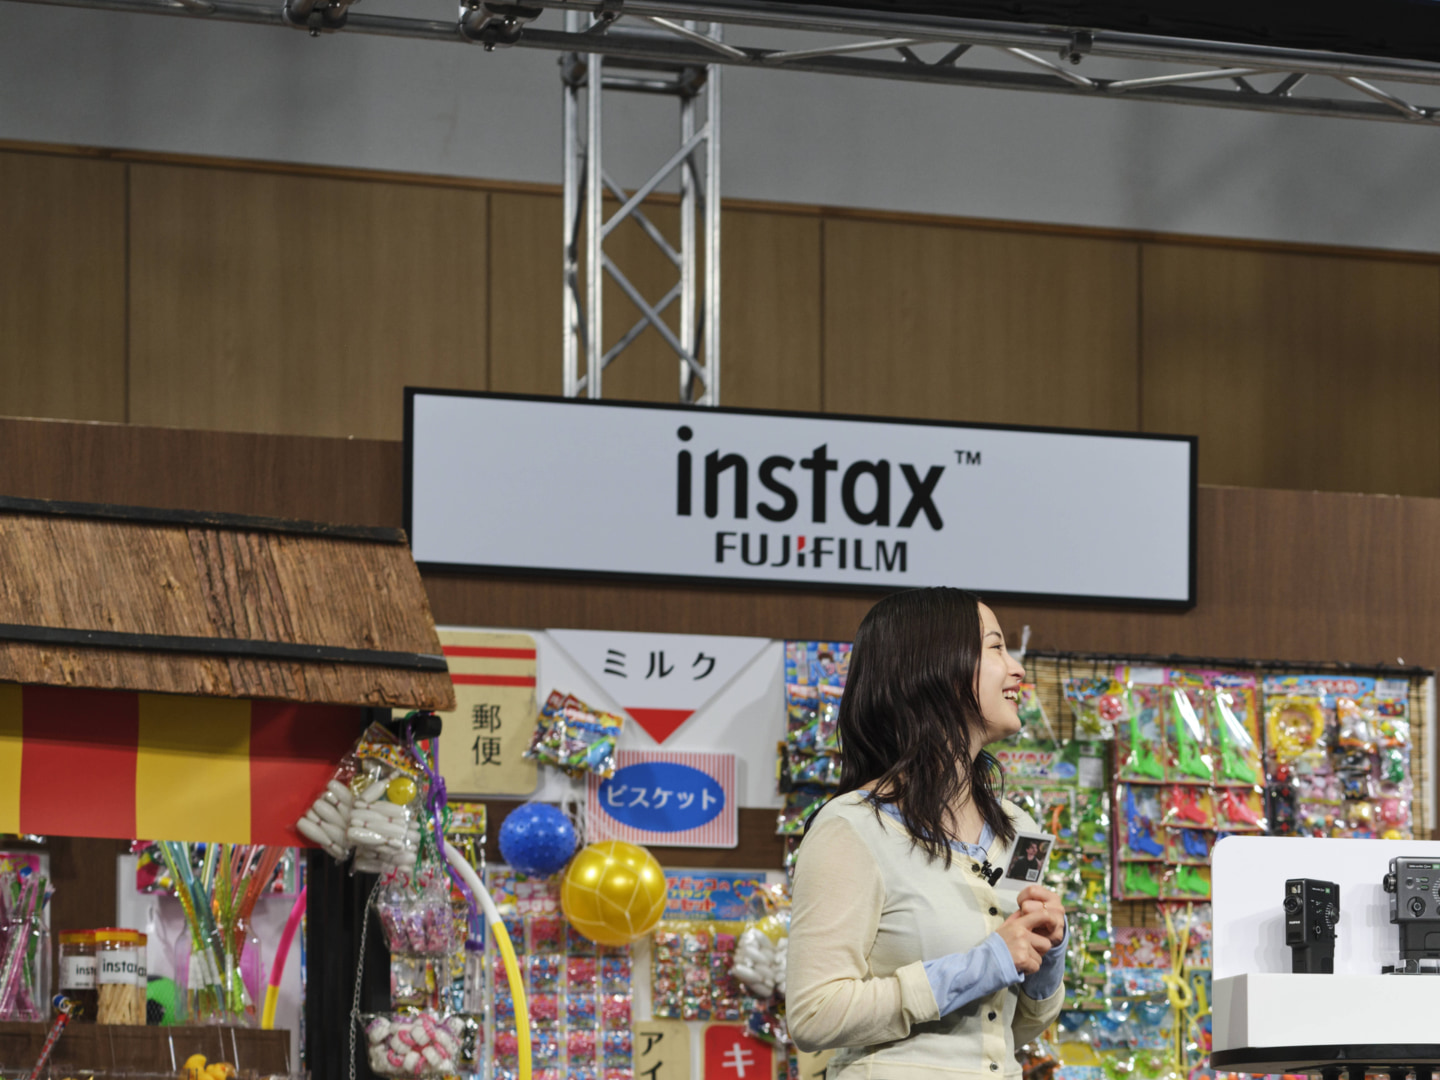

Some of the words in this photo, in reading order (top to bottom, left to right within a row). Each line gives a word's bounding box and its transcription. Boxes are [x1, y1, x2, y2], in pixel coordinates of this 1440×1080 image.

[677, 425, 946, 531] instax
[715, 532, 907, 573] FUJIFILM
[604, 649, 716, 681] ミルク
[471, 703, 502, 766] 郵便
[607, 784, 717, 811] ビスケット
